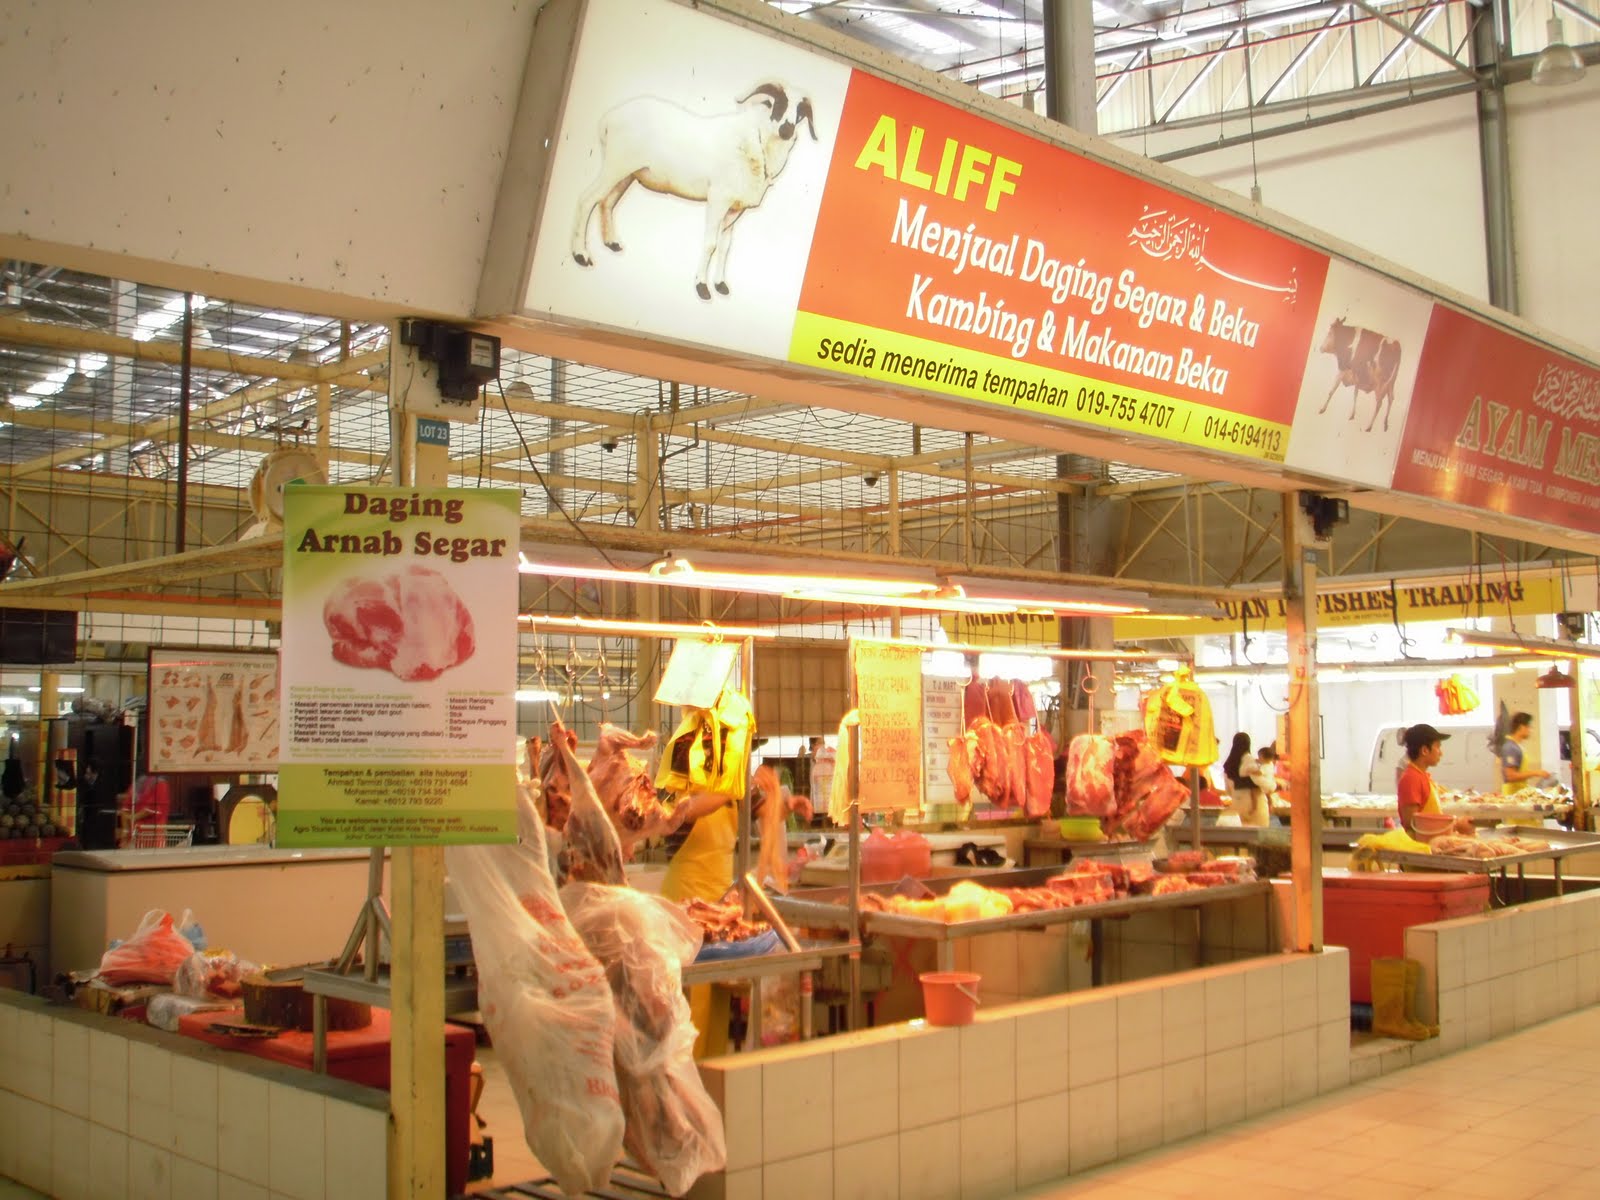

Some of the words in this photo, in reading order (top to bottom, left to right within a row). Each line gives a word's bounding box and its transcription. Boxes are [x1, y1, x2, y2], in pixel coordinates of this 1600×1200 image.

[854, 114, 1023, 212] ALIFF
[890, 198, 1019, 275] Menjual
[1020, 238, 1113, 315] Daging
[1114, 268, 1187, 328] Segar
[1189, 293, 1205, 334] &
[1208, 299, 1260, 348] Beku
[905, 273, 1035, 358] Kambing
[1037, 309, 1056, 353] &
[1060, 315, 1174, 381] Makanan
[1174, 347, 1229, 395] Beku
[817, 337, 876, 369] sedia
[880, 350, 979, 390] menerima
[982, 368, 1069, 408] tempahan
[1076, 386, 1138, 421] 019-755
[1139, 401, 1175, 429] 4707
[1204, 415, 1282, 452] 014-6194113
[420, 425, 436, 438] LOT
[437, 427, 448, 440] 23
[1455, 394, 1553, 470] AYAM
[1411, 447, 1450, 473] MENJUAL
[343, 492, 464, 524] Daging
[297, 528, 403, 556] Arnab
[414, 531, 506, 563] Segar
[1404, 581, 1525, 608] TRADING
